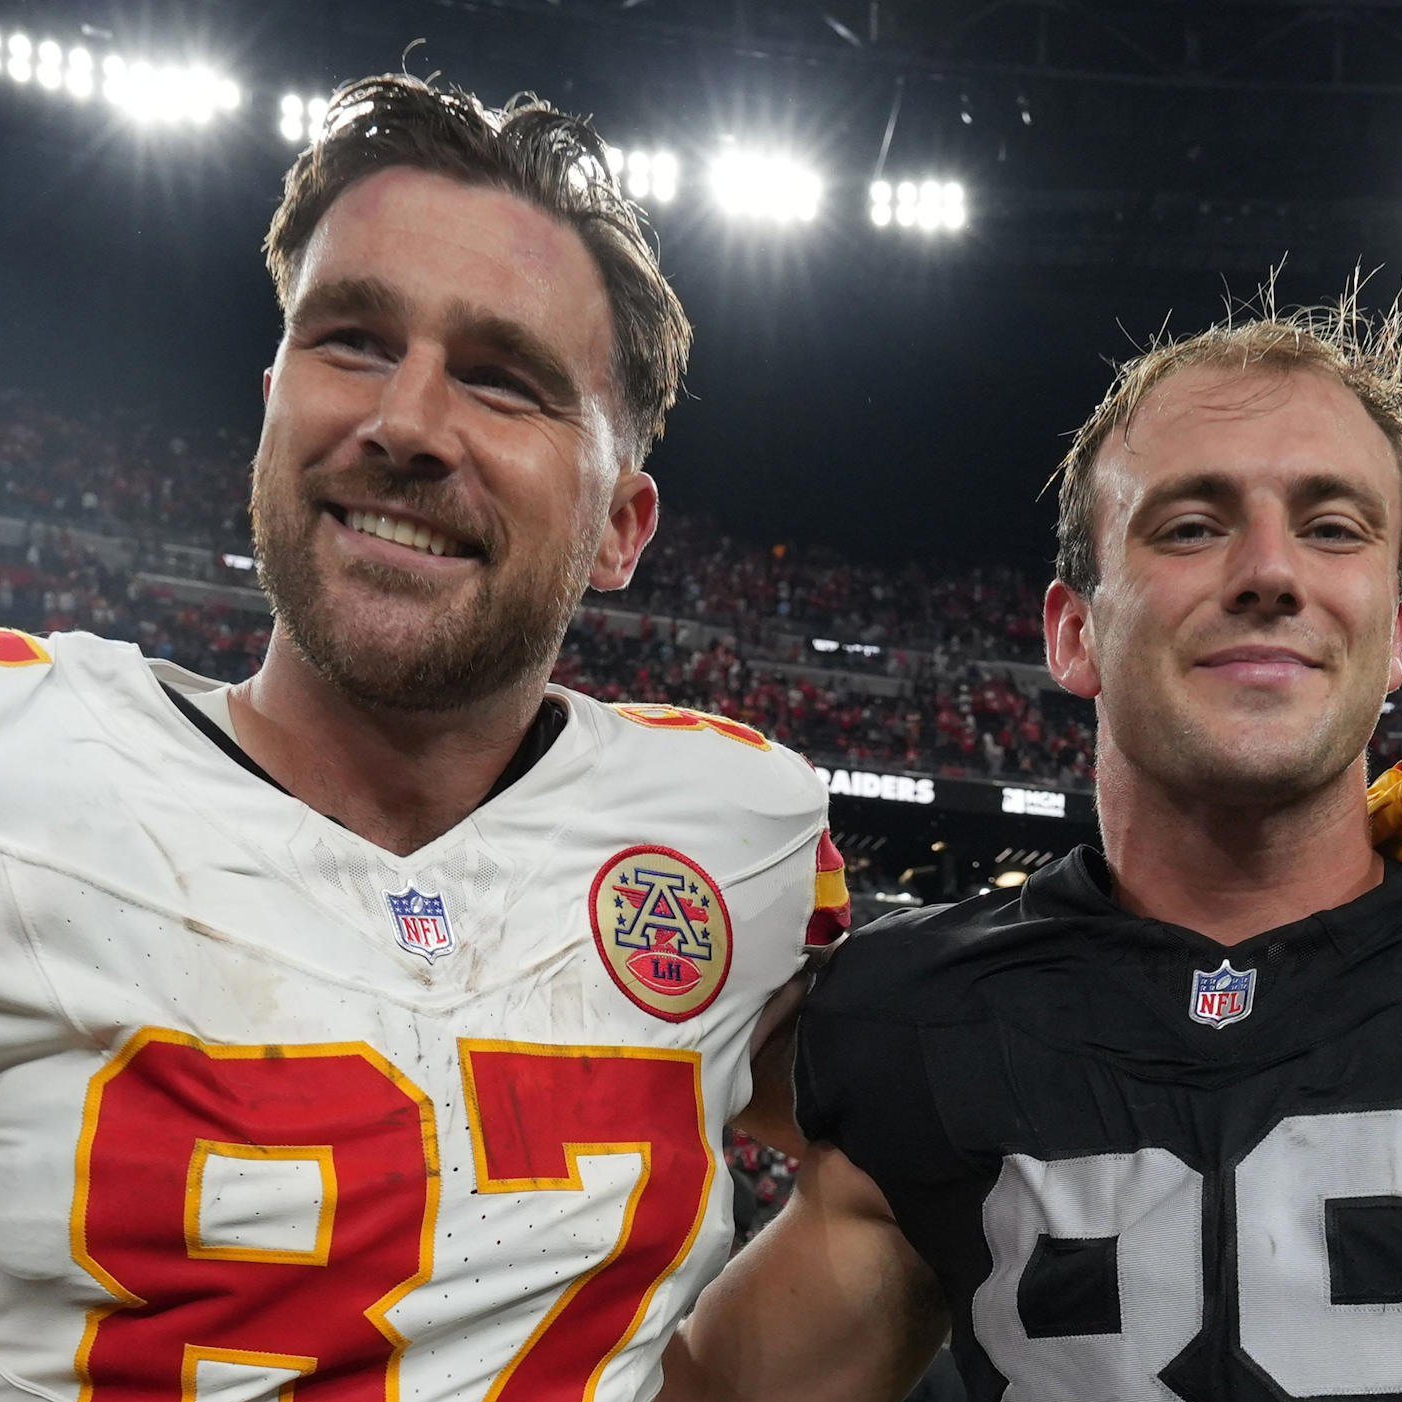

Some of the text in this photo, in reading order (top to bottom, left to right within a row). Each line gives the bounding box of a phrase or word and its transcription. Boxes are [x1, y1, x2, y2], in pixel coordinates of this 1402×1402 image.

[401, 916, 447, 948] NFL
[651, 959, 683, 982] LH
[1199, 993, 1242, 1017] NFL
